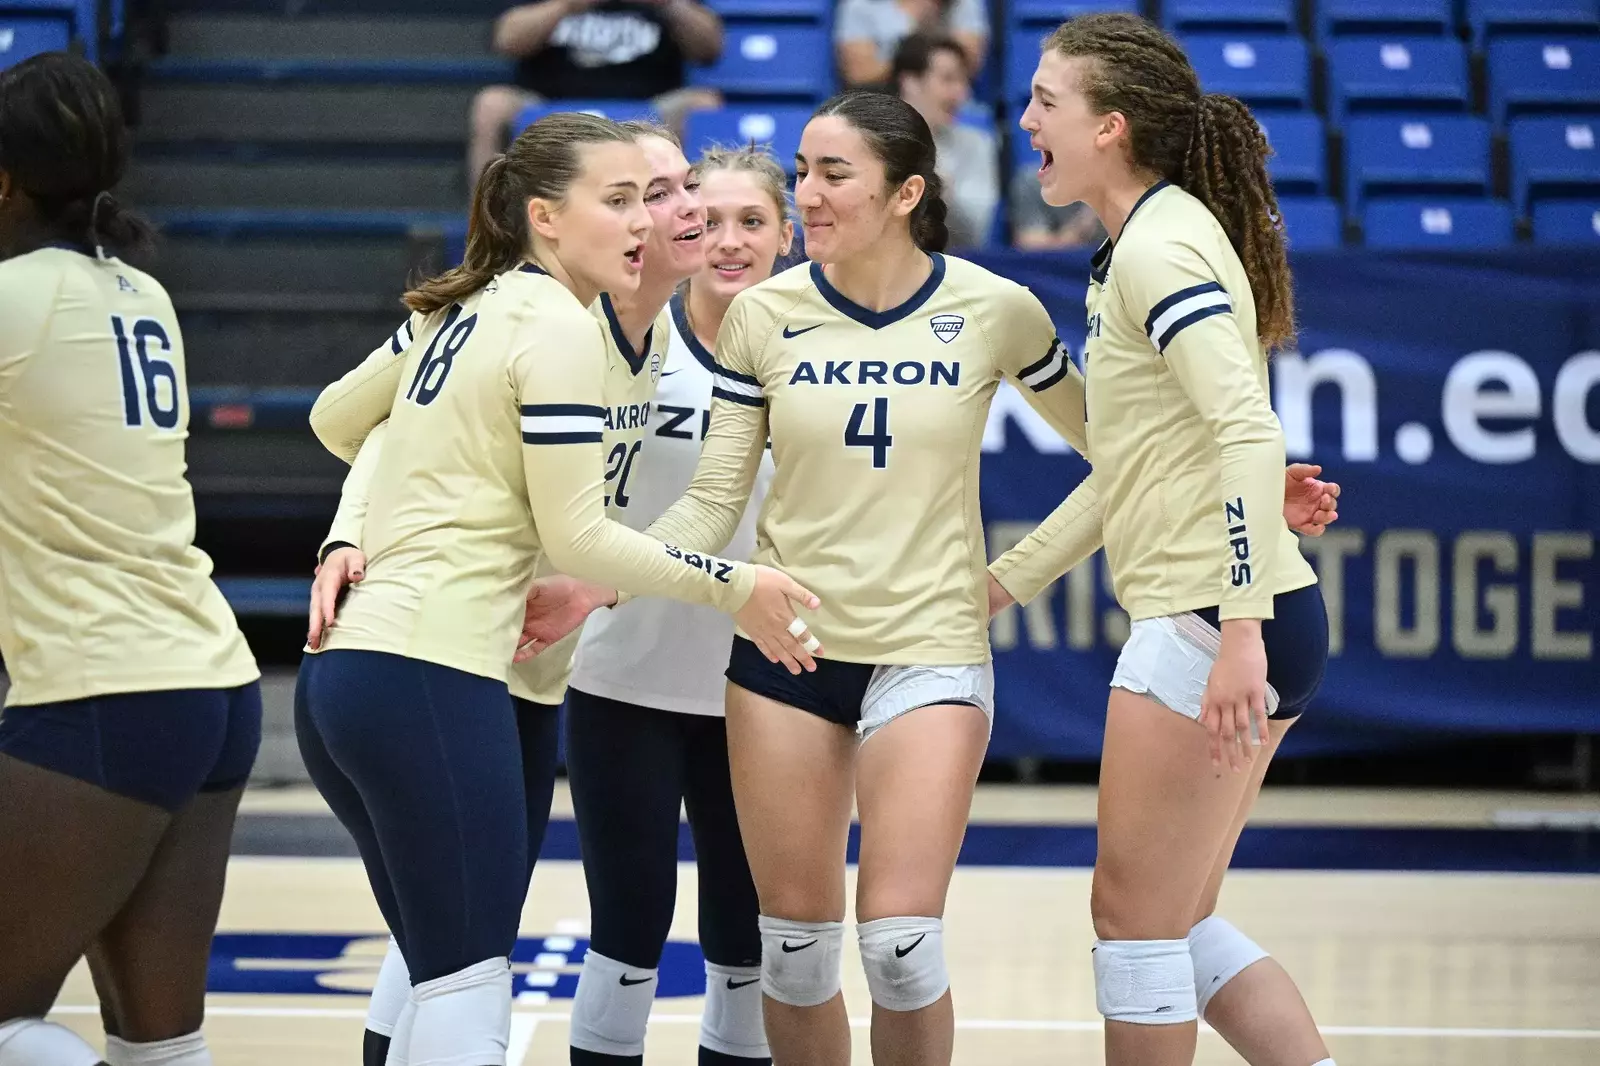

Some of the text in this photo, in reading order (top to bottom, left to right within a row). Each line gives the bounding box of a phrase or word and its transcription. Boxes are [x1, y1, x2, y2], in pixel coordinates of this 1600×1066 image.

[406, 303, 478, 406] 18
[932, 323, 962, 332] MAC
[111, 315, 180, 429] 16
[788, 360, 960, 387] AKRON
[844, 397, 893, 468] 4
[1225, 496, 1251, 587] ZIPS
